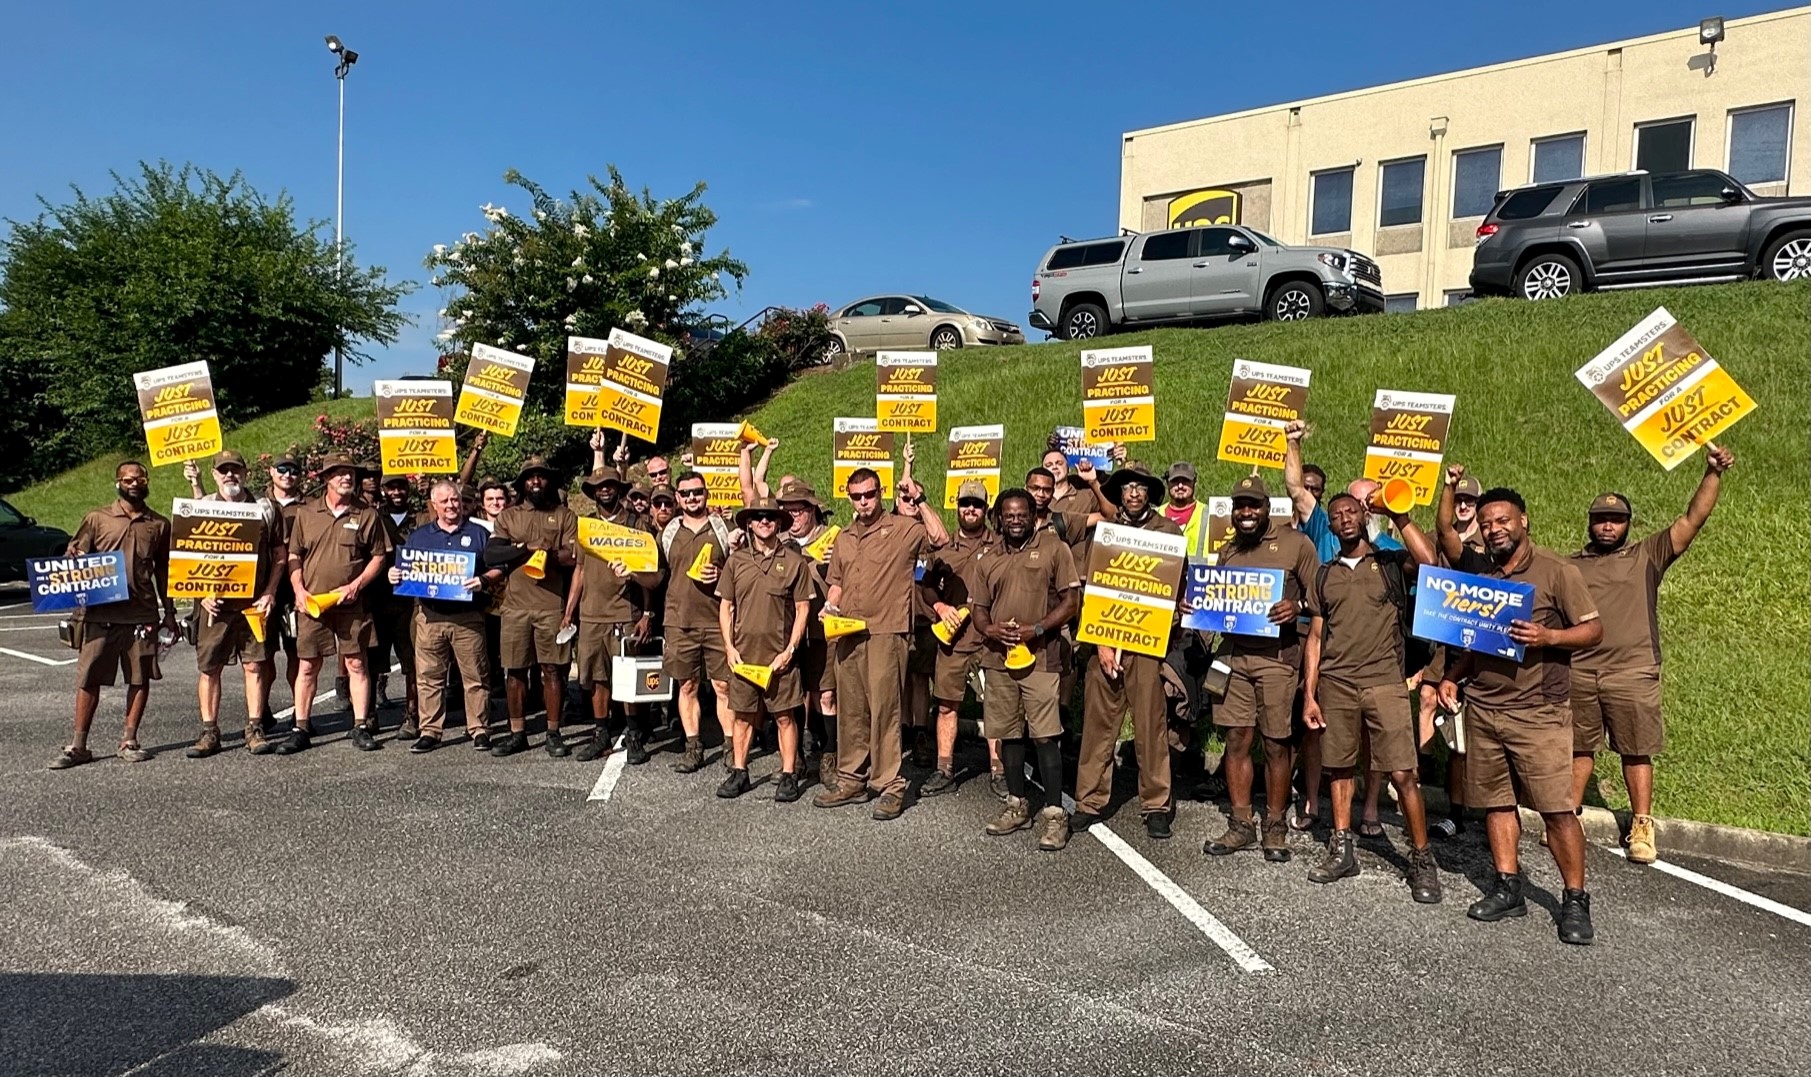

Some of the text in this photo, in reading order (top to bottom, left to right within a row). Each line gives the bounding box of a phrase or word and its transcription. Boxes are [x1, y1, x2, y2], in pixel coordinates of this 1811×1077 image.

[1604, 321, 1667, 372] UPS TEAMSTERS
[582, 356, 604, 369] JU
[618, 354, 654, 374] JUST
[1111, 354, 1146, 362] TEAMSTERS
[480, 364, 517, 380] JUST
[890, 368, 924, 380] JUST
[1098, 366, 1138, 382] JUST
[1620, 342, 1665, 391] JUST
[607, 368, 660, 396] PRACTICING
[1266, 373, 1303, 384] TEAMSTERS
[1618, 352, 1702, 417] PRACTICING
[154, 383, 194, 402] JUST
[468, 376, 522, 398] PRACTICING
[880, 384, 933, 392] PRACTICING
[1088, 384, 1149, 398] PRACTICING
[1246, 383, 1291, 400] JUST
[582, 395, 598, 406] JU
[1659, 386, 1682, 405] FOR A
[146, 399, 210, 420] PRACTICING
[394, 399, 437, 412] JUST
[472, 398, 508, 414] JUST
[613, 396, 646, 415] JUST
[890, 402, 924, 414] JUST
[1232, 401, 1298, 420] PRACTICING
[1408, 402, 1446, 410] TEAMSTERS
[1660, 385, 1705, 432] JUST
[460, 410, 512, 432] CONTRACT
[601, 410, 654, 435] CONTRACT
[1100, 407, 1138, 422] JUST
[1388, 414, 1432, 430] JUST
[384, 418, 450, 428] PRACTICING
[882, 418, 932, 428] CONTRACT
[1662, 396, 1740, 458] CONTRACT
[164, 423, 203, 442] JUST
[847, 434, 882, 446] JUST
[1090, 426, 1148, 438] CONTRACT
[1239, 426, 1282, 444] JUST
[156, 440, 216, 459] CONTRACT
[398, 439, 439, 452] JUST
[706, 440, 741, 452] JUST
[958, 442, 990, 454] JUST
[1373, 434, 1440, 450] PRACTICING
[838, 450, 890, 460] PRACTICING
[1060, 446, 1108, 457] CONTRACT
[1225, 444, 1287, 462] CONTRACT
[388, 458, 452, 468] CONTRACT
[950, 458, 996, 468] PRACTICING
[1380, 461, 1424, 478] JUST
[707, 476, 739, 487] JUST
[212, 509, 254, 518] TEAMSTERS
[192, 521, 242, 536] JUST
[176, 539, 252, 551] PRACTICING
[590, 537, 646, 548] WAGES!
[1116, 536, 1179, 553] UPS TEAMSTERS
[34, 555, 117, 573] UNITED
[402, 549, 468, 564] UNITED
[1110, 551, 1163, 574] JUST
[49, 565, 116, 586] STRONG
[188, 563, 238, 577] JUST
[412, 562, 465, 574] STRONG
[402, 570, 468, 586] CONTRACT
[1092, 571, 1172, 597] PRACTICING
[1194, 568, 1276, 587] UNITED
[38, 576, 119, 596] CONTRACT
[174, 582, 248, 592] CONTRACT
[1205, 584, 1272, 600] STRONG
[1426, 576, 1524, 607] NO MORE
[1192, 596, 1274, 615] CONTRACT
[1442, 590, 1506, 620] Tiers!
[1101, 604, 1152, 625] JUST
[1448, 614, 1478, 626] CONTRACT
[1085, 623, 1161, 648] CONTRACT
[648, 677, 660, 688] ups
